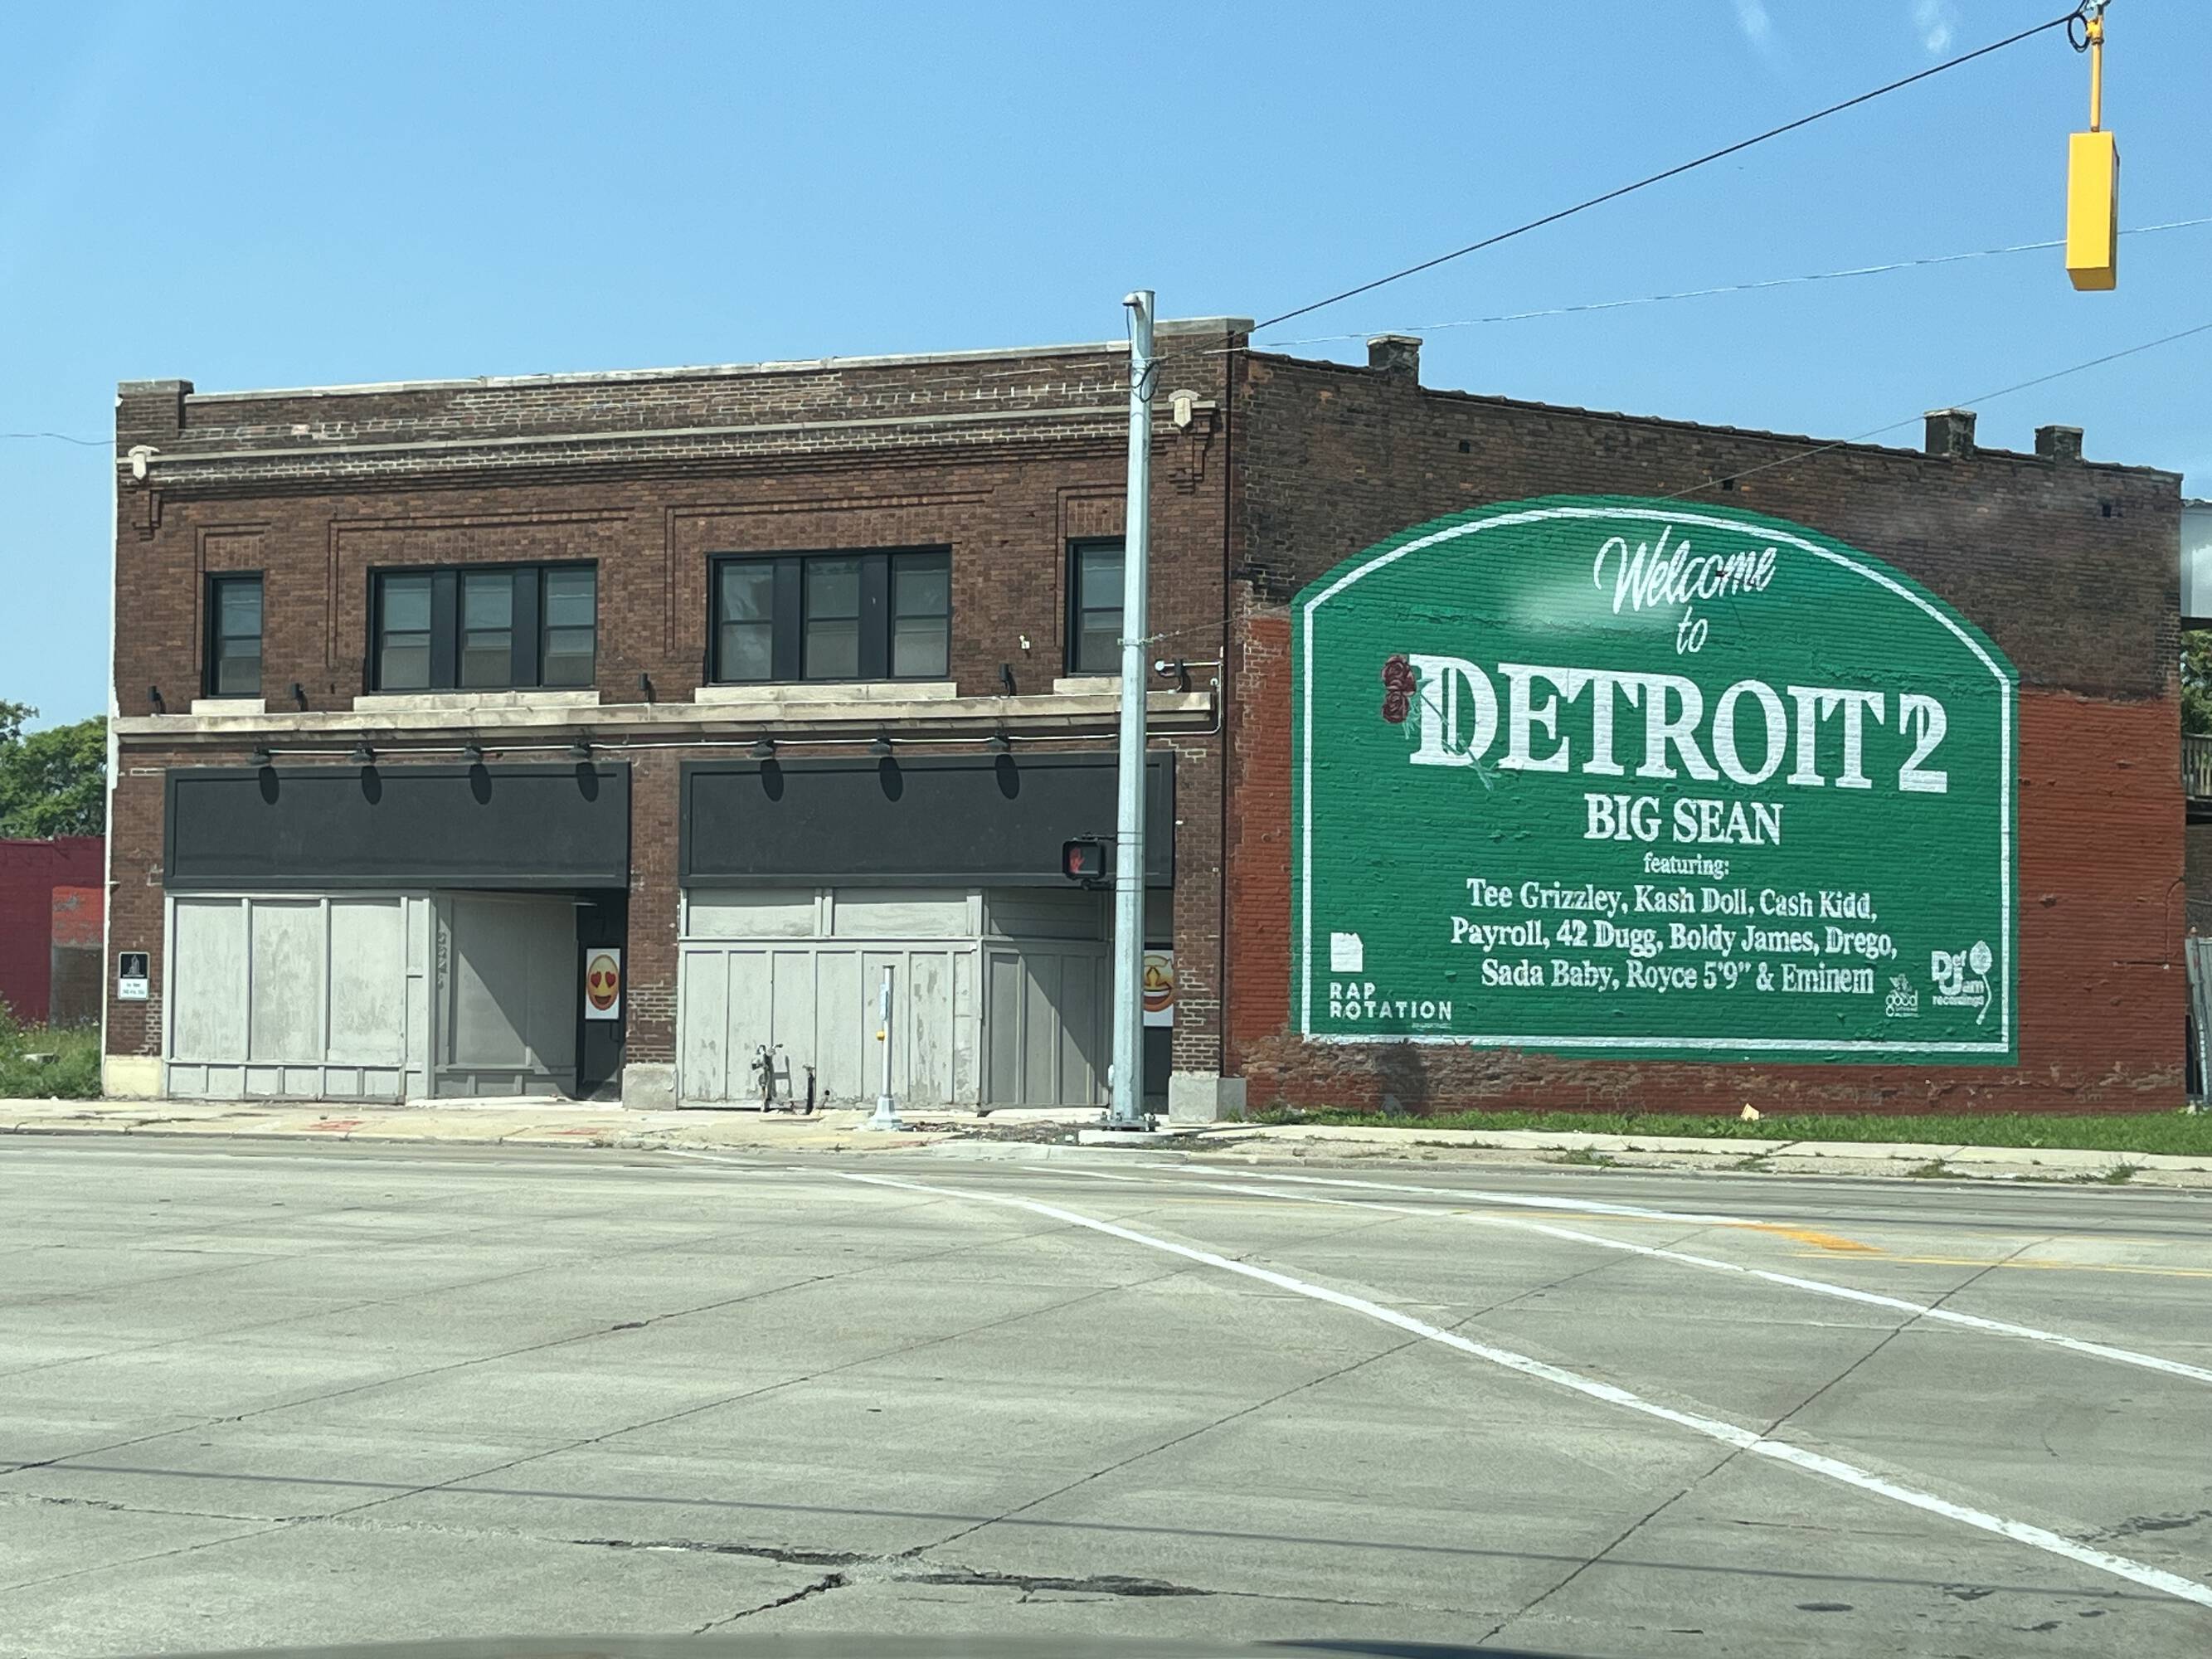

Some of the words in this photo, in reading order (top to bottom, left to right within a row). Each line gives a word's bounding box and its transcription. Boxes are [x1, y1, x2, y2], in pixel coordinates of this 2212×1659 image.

[1594, 525, 1777, 615] Welcome
[1676, 606, 1709, 654] to
[1409, 654, 1884, 789] DETROIT
[1898, 693, 1947, 793] 2
[1583, 793, 1662, 842] BIG
[1673, 797, 1784, 845] SEAN
[1643, 851, 1729, 880] featuring:
[1466, 878, 1513, 907] Tee
[1519, 881, 1628, 918] Grizzley,
[1634, 884, 1695, 913] Kash
[1700, 888, 1755, 917] Doll,
[1759, 888, 1814, 917] Cash
[1818, 890, 1878, 923] Kidd,
[1450, 916, 1550, 952] Payroll,
[1556, 919, 1587, 947] 42
[1592, 919, 1664, 958] Dugg,
[1669, 922, 1737, 957] Boldy
[1741, 925, 1820, 956] James,
[1825, 926, 1898, 960] Drego,
[1481, 958, 1544, 986] Sada
[1550, 959, 1620, 992] Baby,
[1626, 959, 1698, 993] Royce
[1756, 961, 1776, 991] &
[1780, 961, 1874, 994] Eminem
[1931, 950, 1966, 981] Def
[1330, 982, 1376, 1000] RAP
[1330, 1000, 1451, 1021] ROTATION
